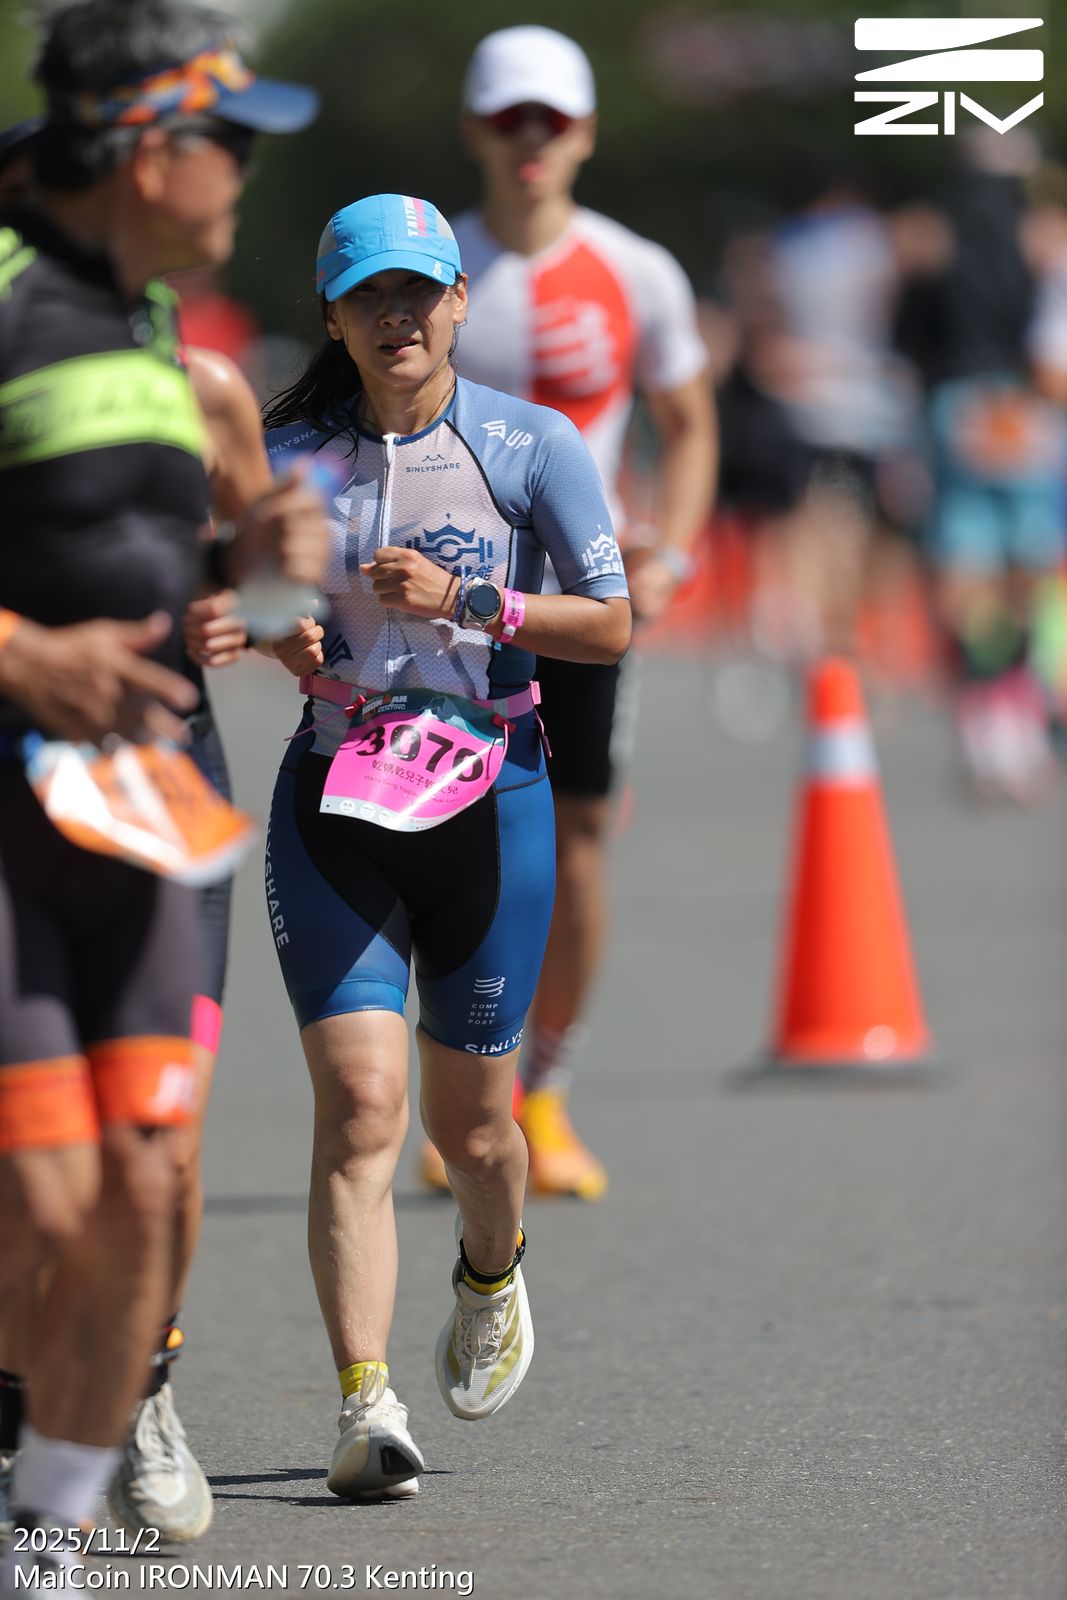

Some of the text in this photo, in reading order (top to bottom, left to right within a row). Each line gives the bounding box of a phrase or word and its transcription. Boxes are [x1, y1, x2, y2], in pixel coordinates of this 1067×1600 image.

[505, 429, 533, 450] UP
[405, 462, 461, 473] SINLYSHARE
[355, 724, 484, 782] 3070
